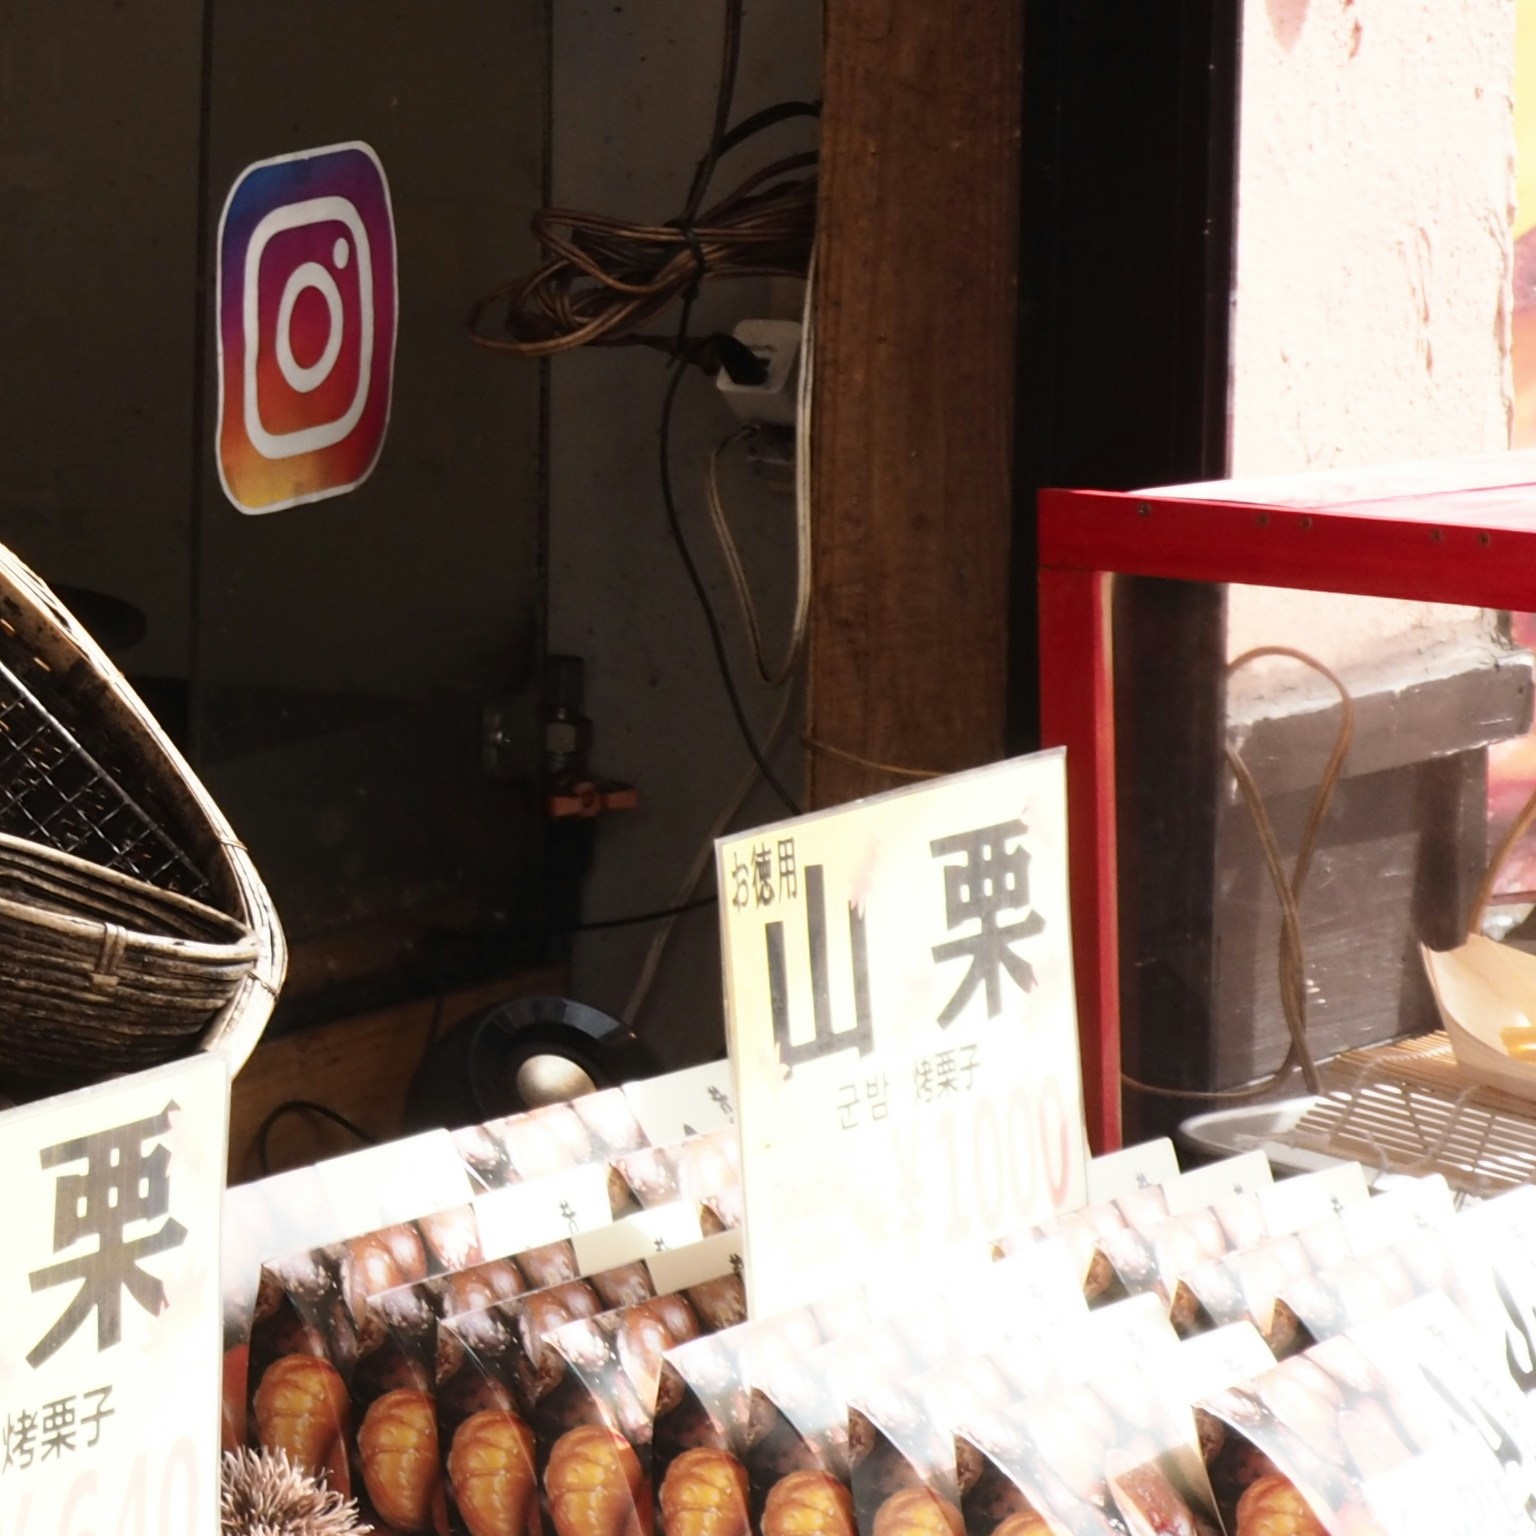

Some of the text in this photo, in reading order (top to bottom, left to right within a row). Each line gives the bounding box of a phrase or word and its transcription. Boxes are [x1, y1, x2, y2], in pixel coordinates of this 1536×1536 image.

[731, 837, 798, 911] お徳用
[766, 817, 1046, 1081] 山栗
[836, 1073, 891, 1131] 군밤
[2, 1384, 116, 1474] 烤栗子
